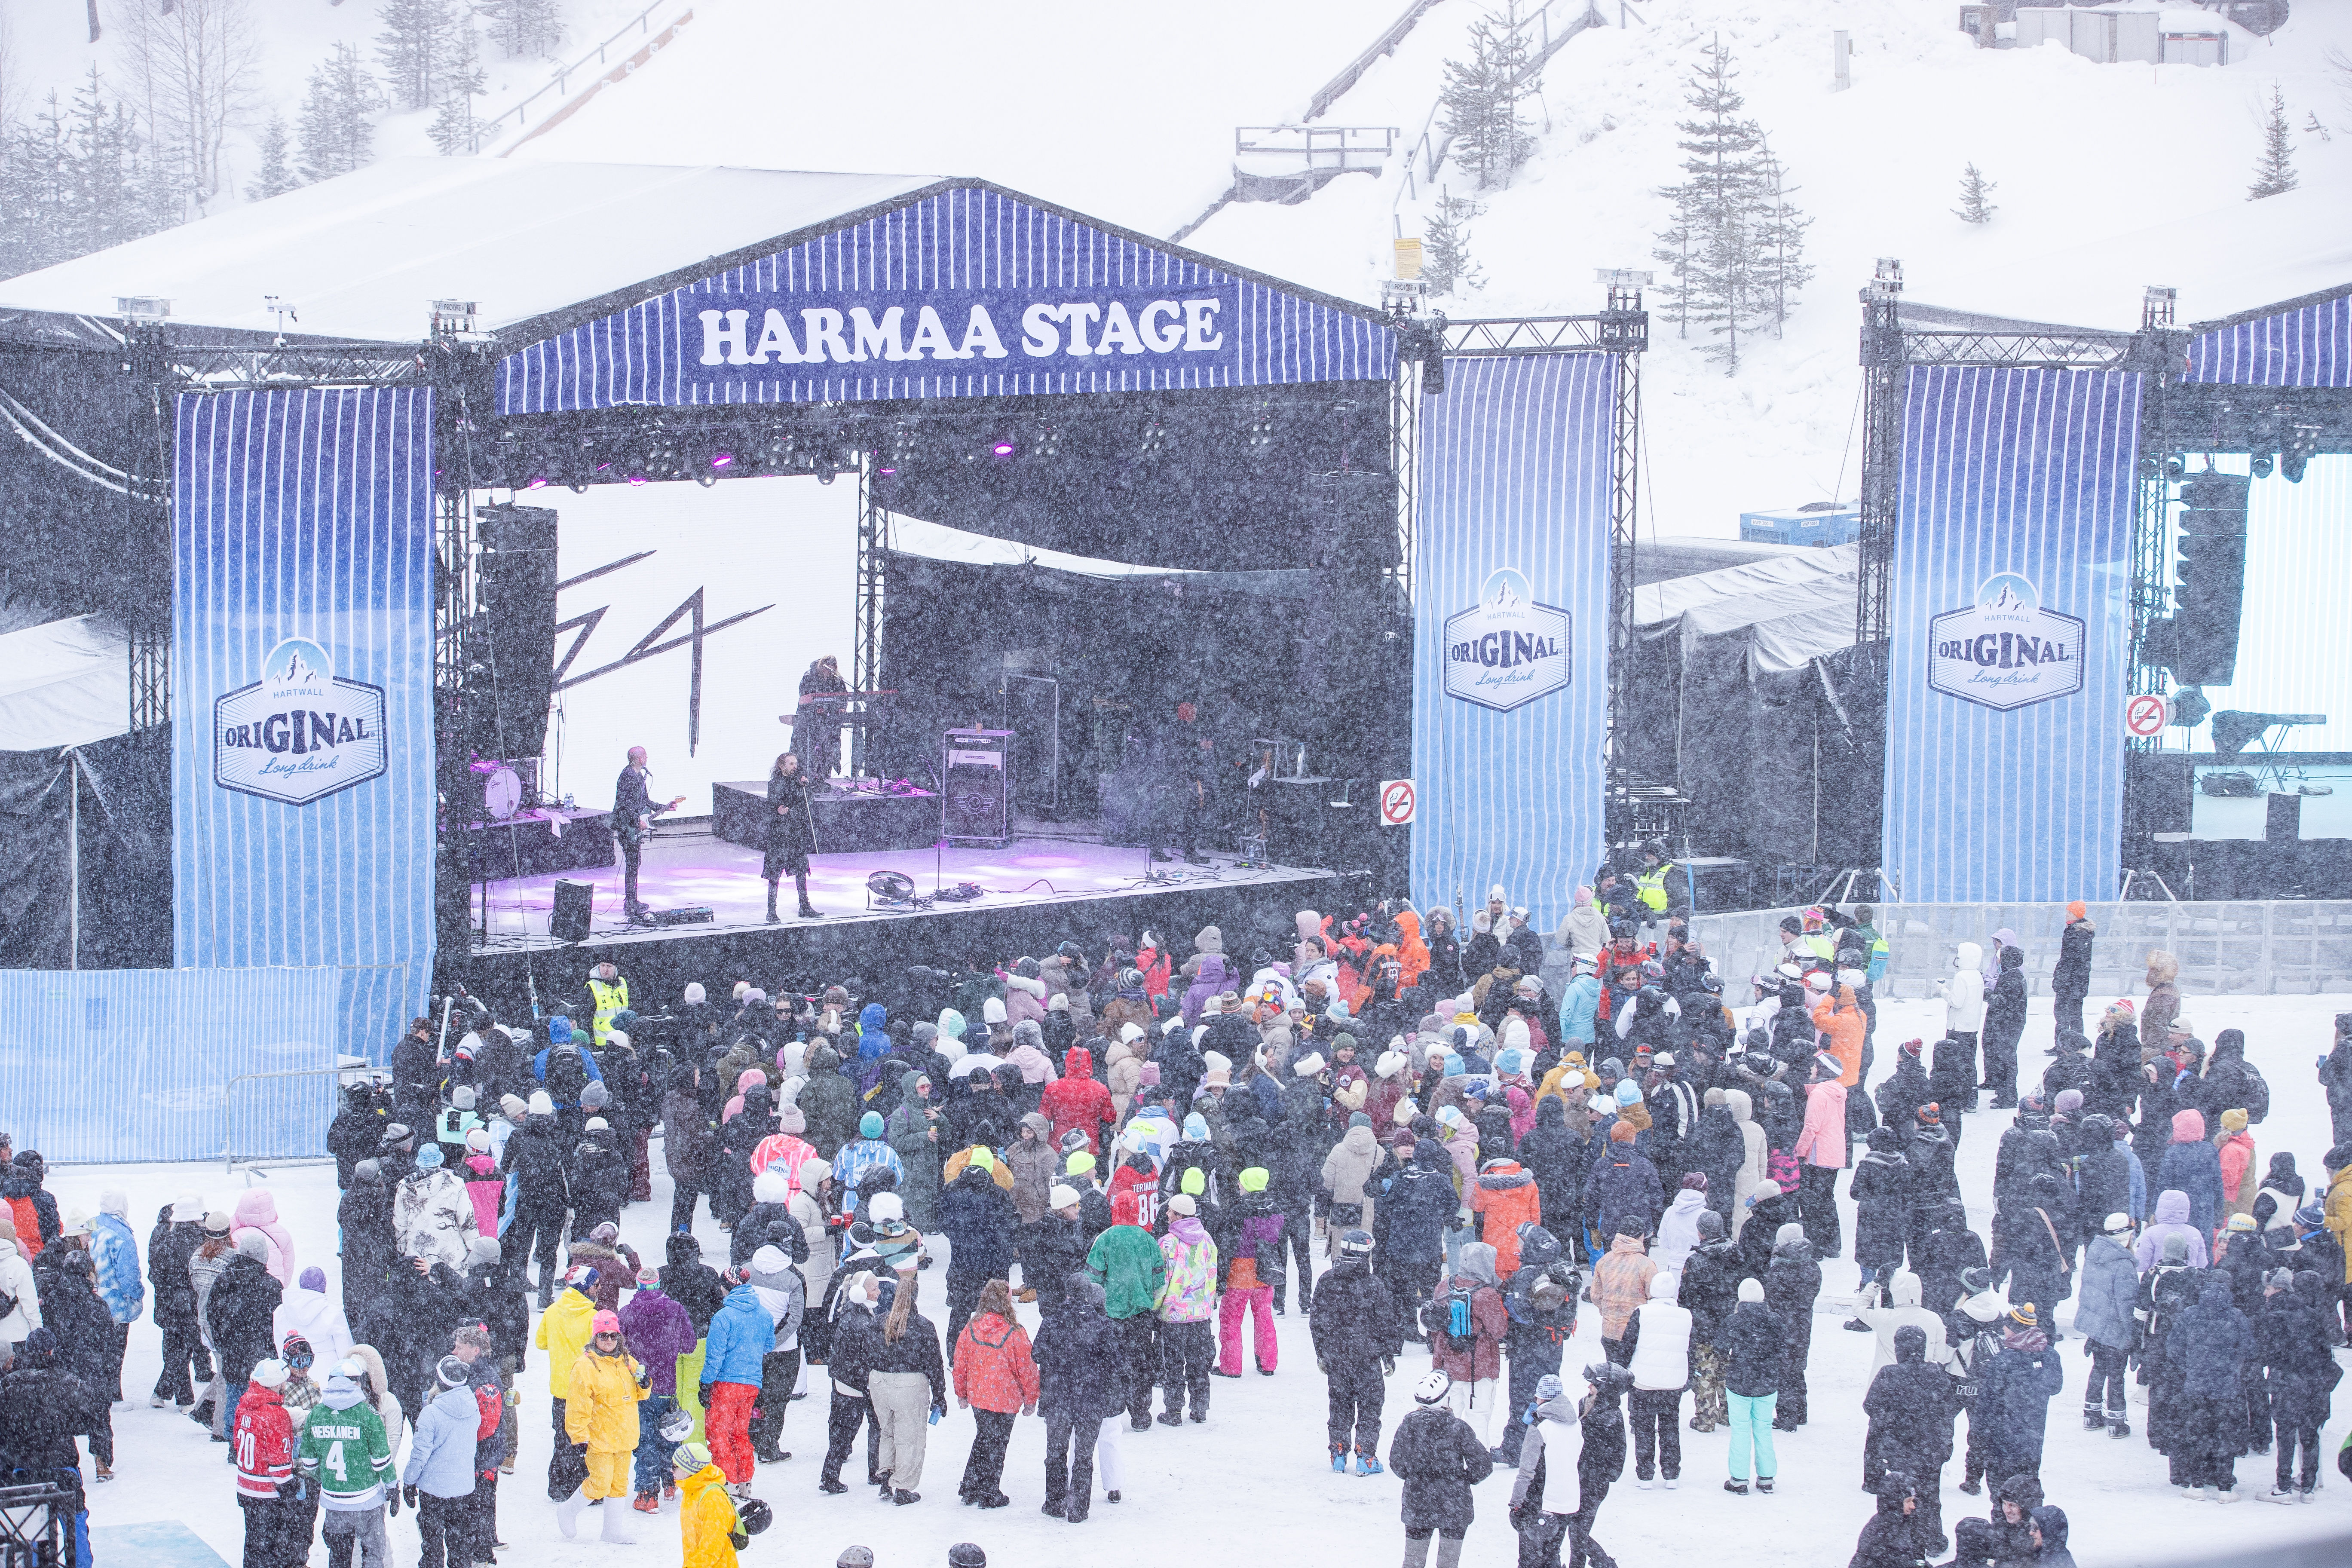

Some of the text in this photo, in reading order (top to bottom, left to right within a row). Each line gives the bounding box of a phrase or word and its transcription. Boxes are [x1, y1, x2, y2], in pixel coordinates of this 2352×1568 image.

[698, 297, 1223, 366] HARMAA STAGE
[1487, 611, 1525, 620] HARTWALL
[1984, 614, 2030, 623] HARTWALL
[1475, 669, 1535, 689] Long drink
[1967, 669, 2041, 688] Long drink
[273, 688, 324, 699] HARTWALL
[258, 755, 340, 779] Long drink
[769, 1165, 790, 1174] ORIGINAL
[1137, 1192, 1159, 1226] 86
[241, 1415, 251, 1429] AHO
[311, 1425, 361, 1439] HEISKANEN
[237, 1428, 255, 1470] 20
[326, 1440, 348, 1481] 4
